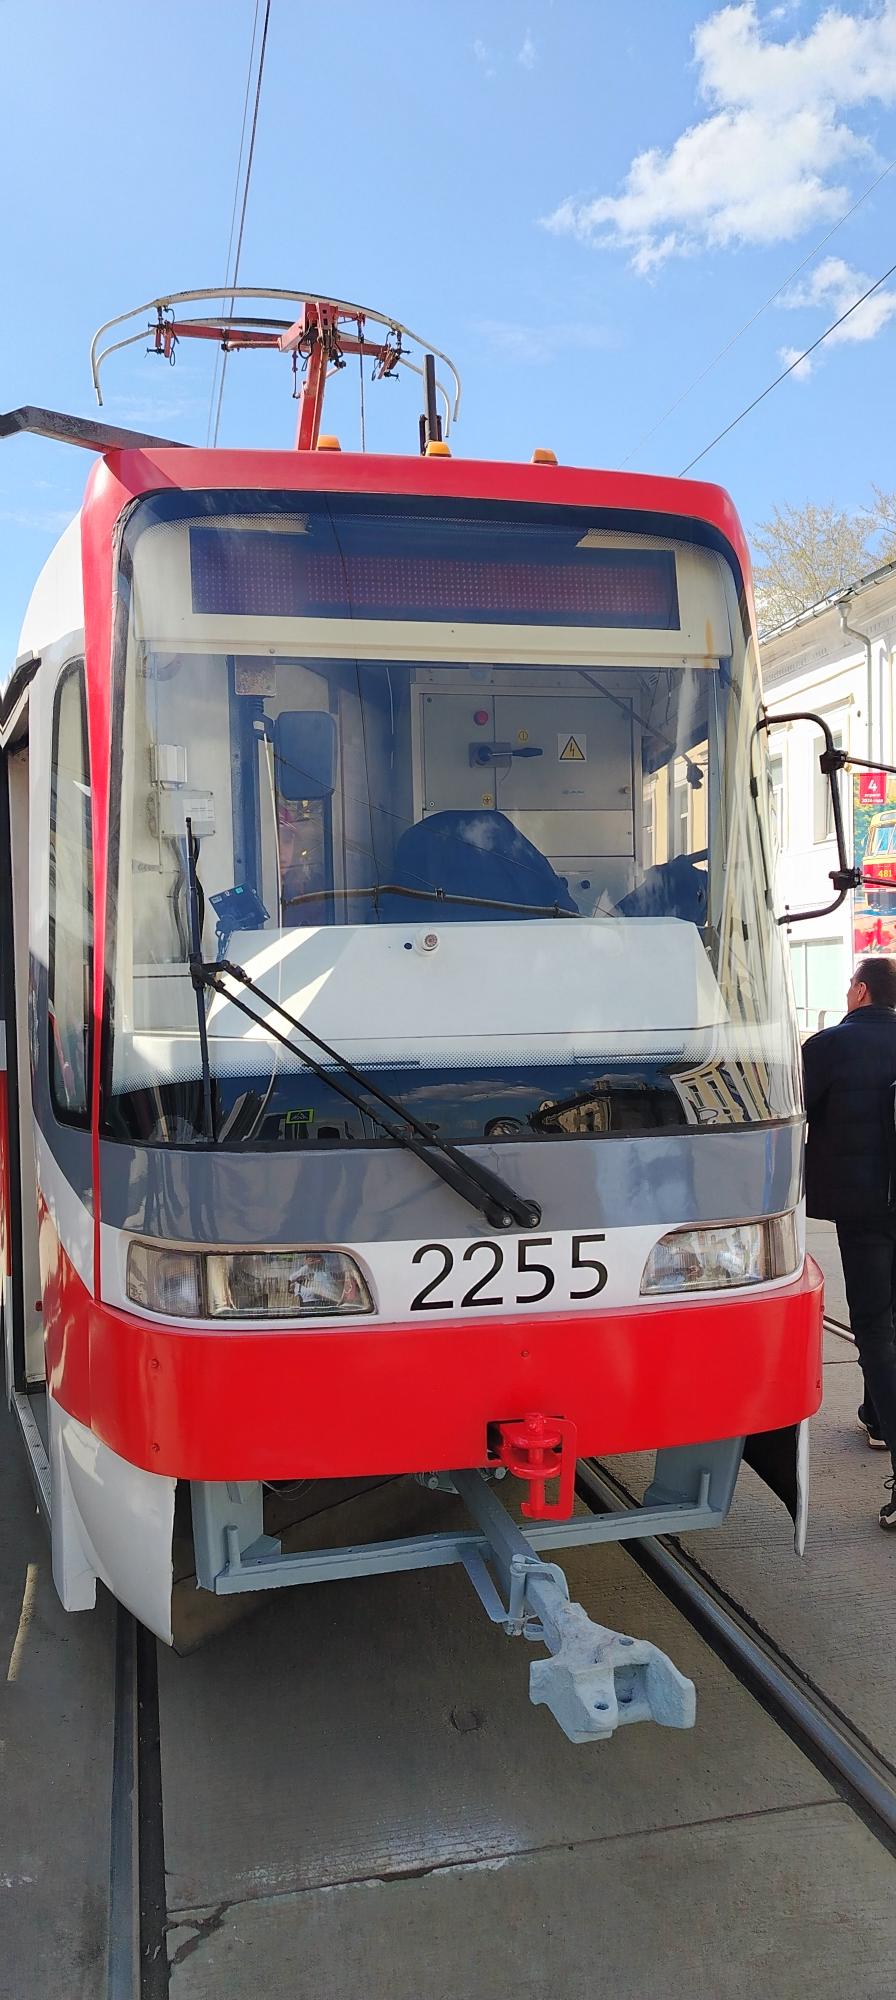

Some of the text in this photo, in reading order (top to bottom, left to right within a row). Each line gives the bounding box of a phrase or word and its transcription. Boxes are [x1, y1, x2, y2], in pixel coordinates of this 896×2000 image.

[868, 779, 878, 792] 4
[878, 869, 892, 878] 481
[410, 1233, 608, 1312] 2255
